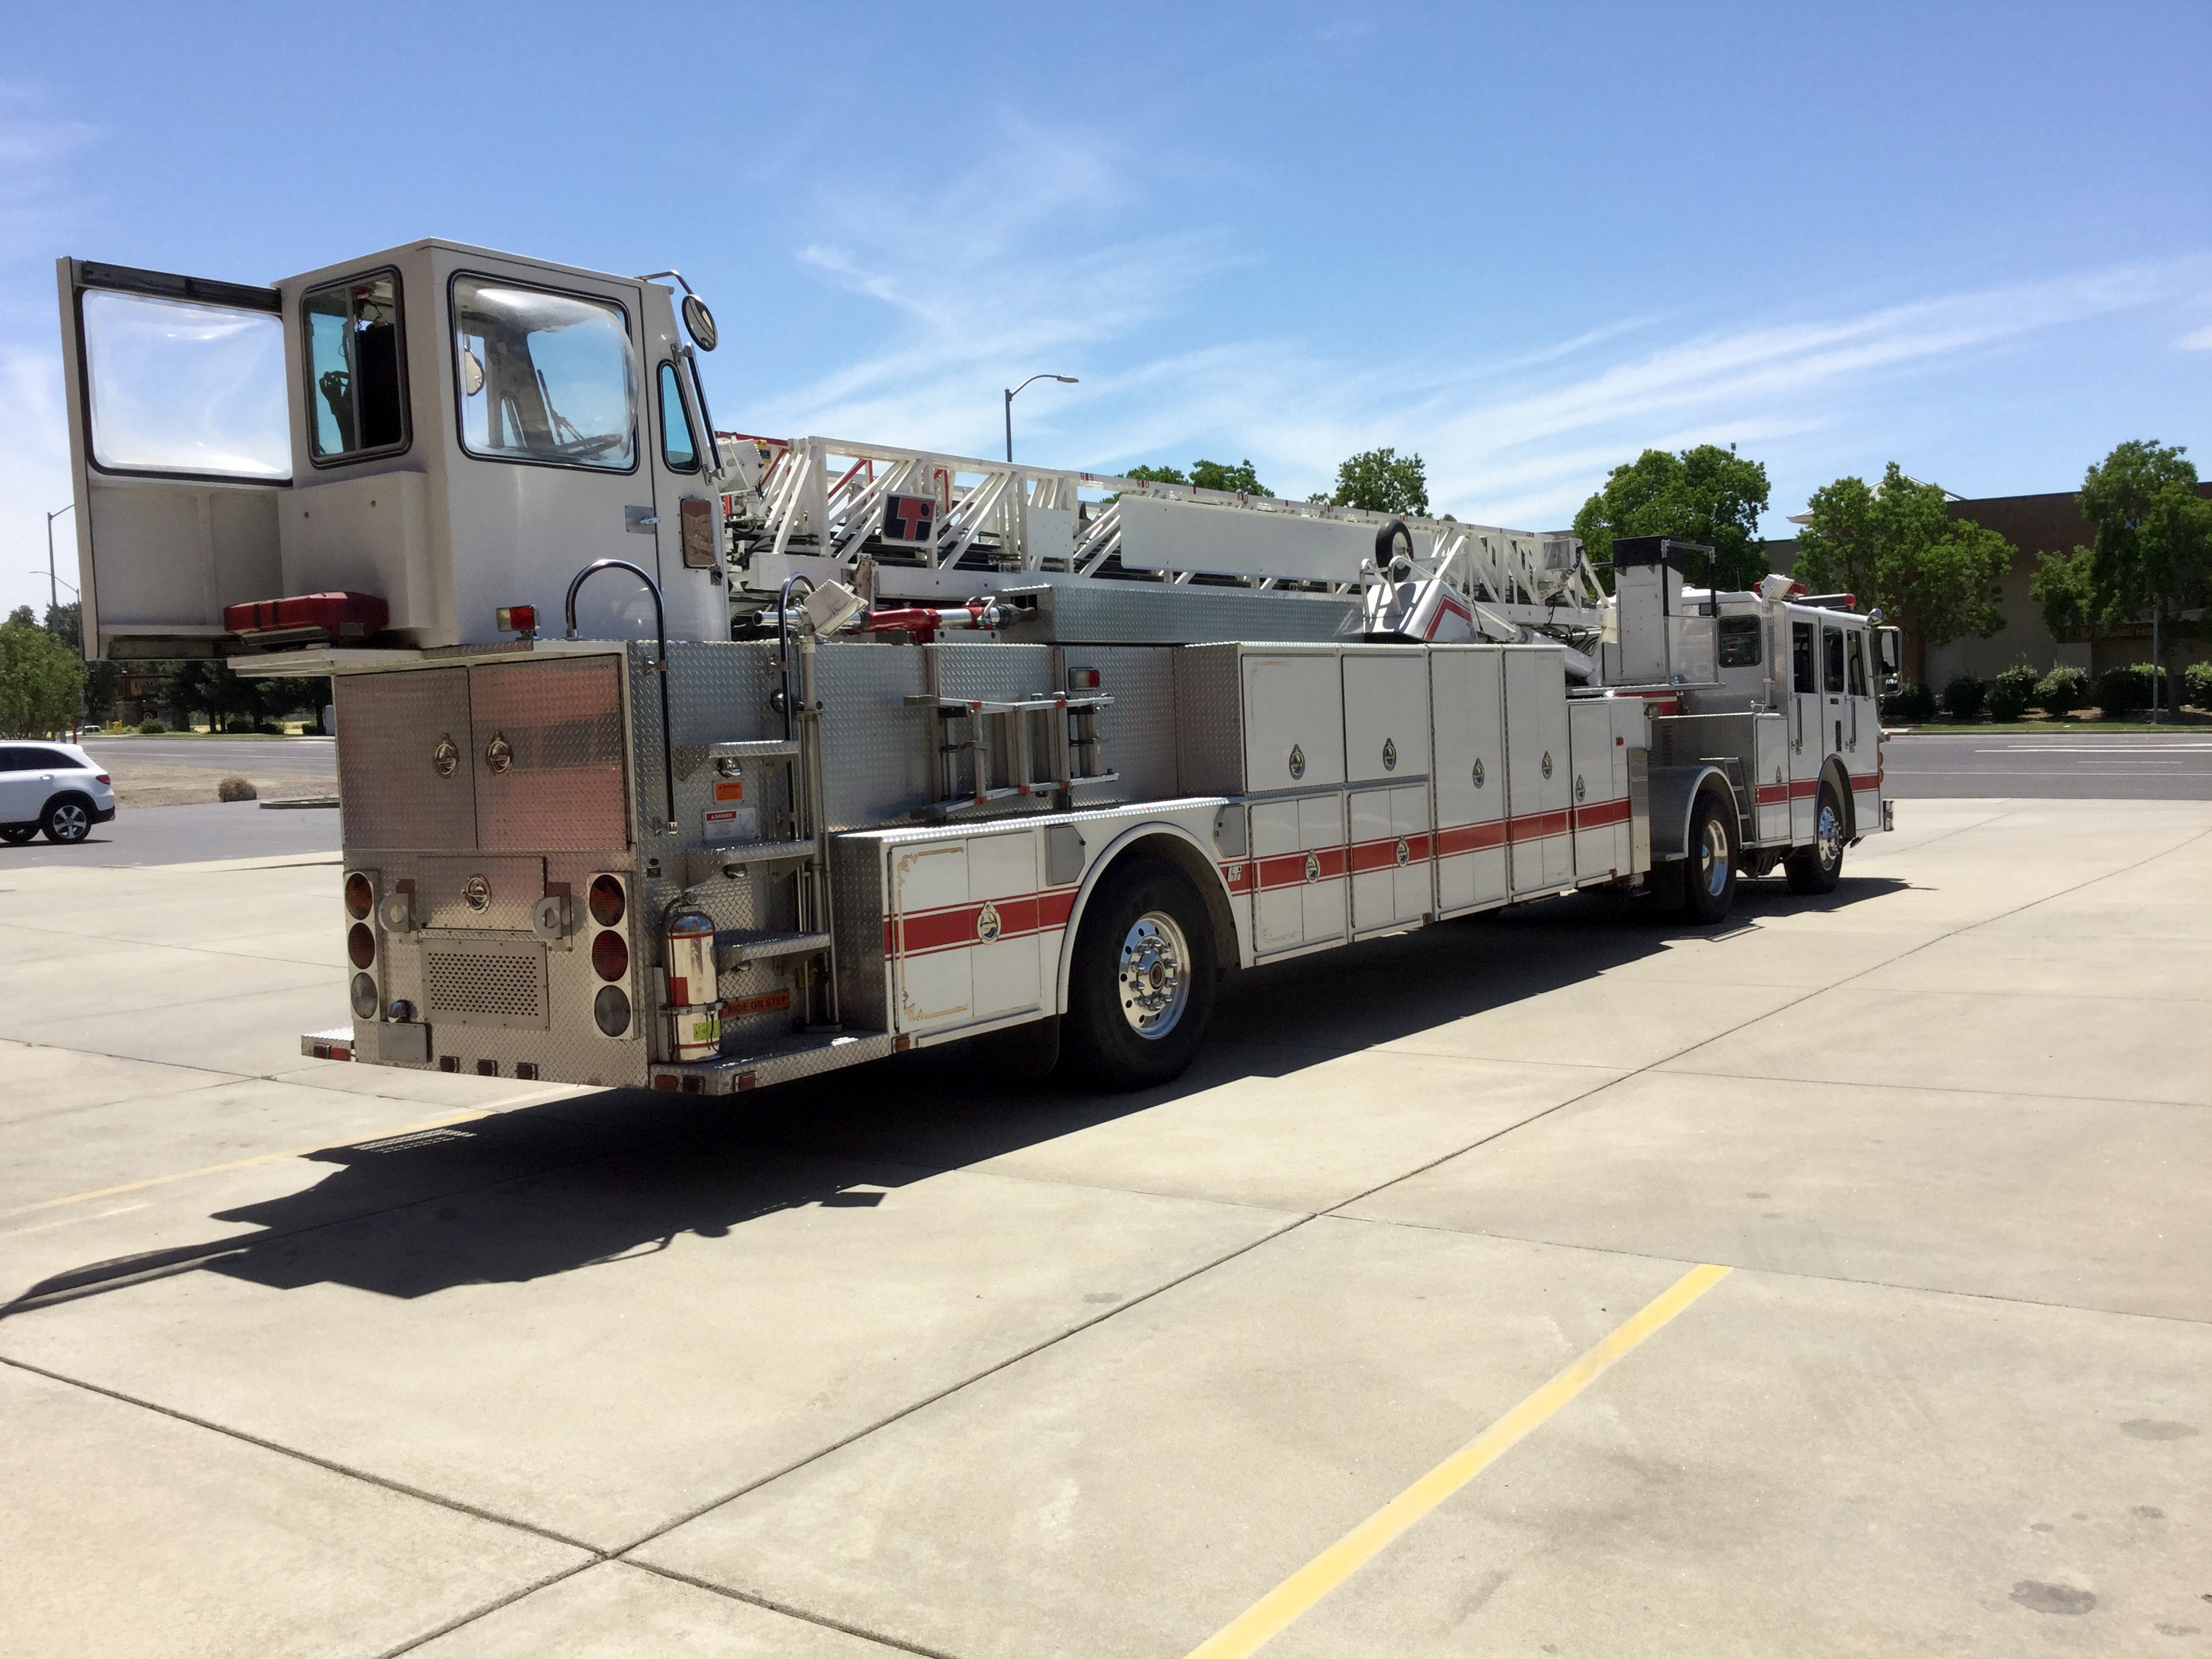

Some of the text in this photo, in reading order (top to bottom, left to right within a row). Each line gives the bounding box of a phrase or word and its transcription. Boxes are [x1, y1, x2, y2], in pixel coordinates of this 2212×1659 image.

[728, 995, 787, 1015] RIDE ON STEP
